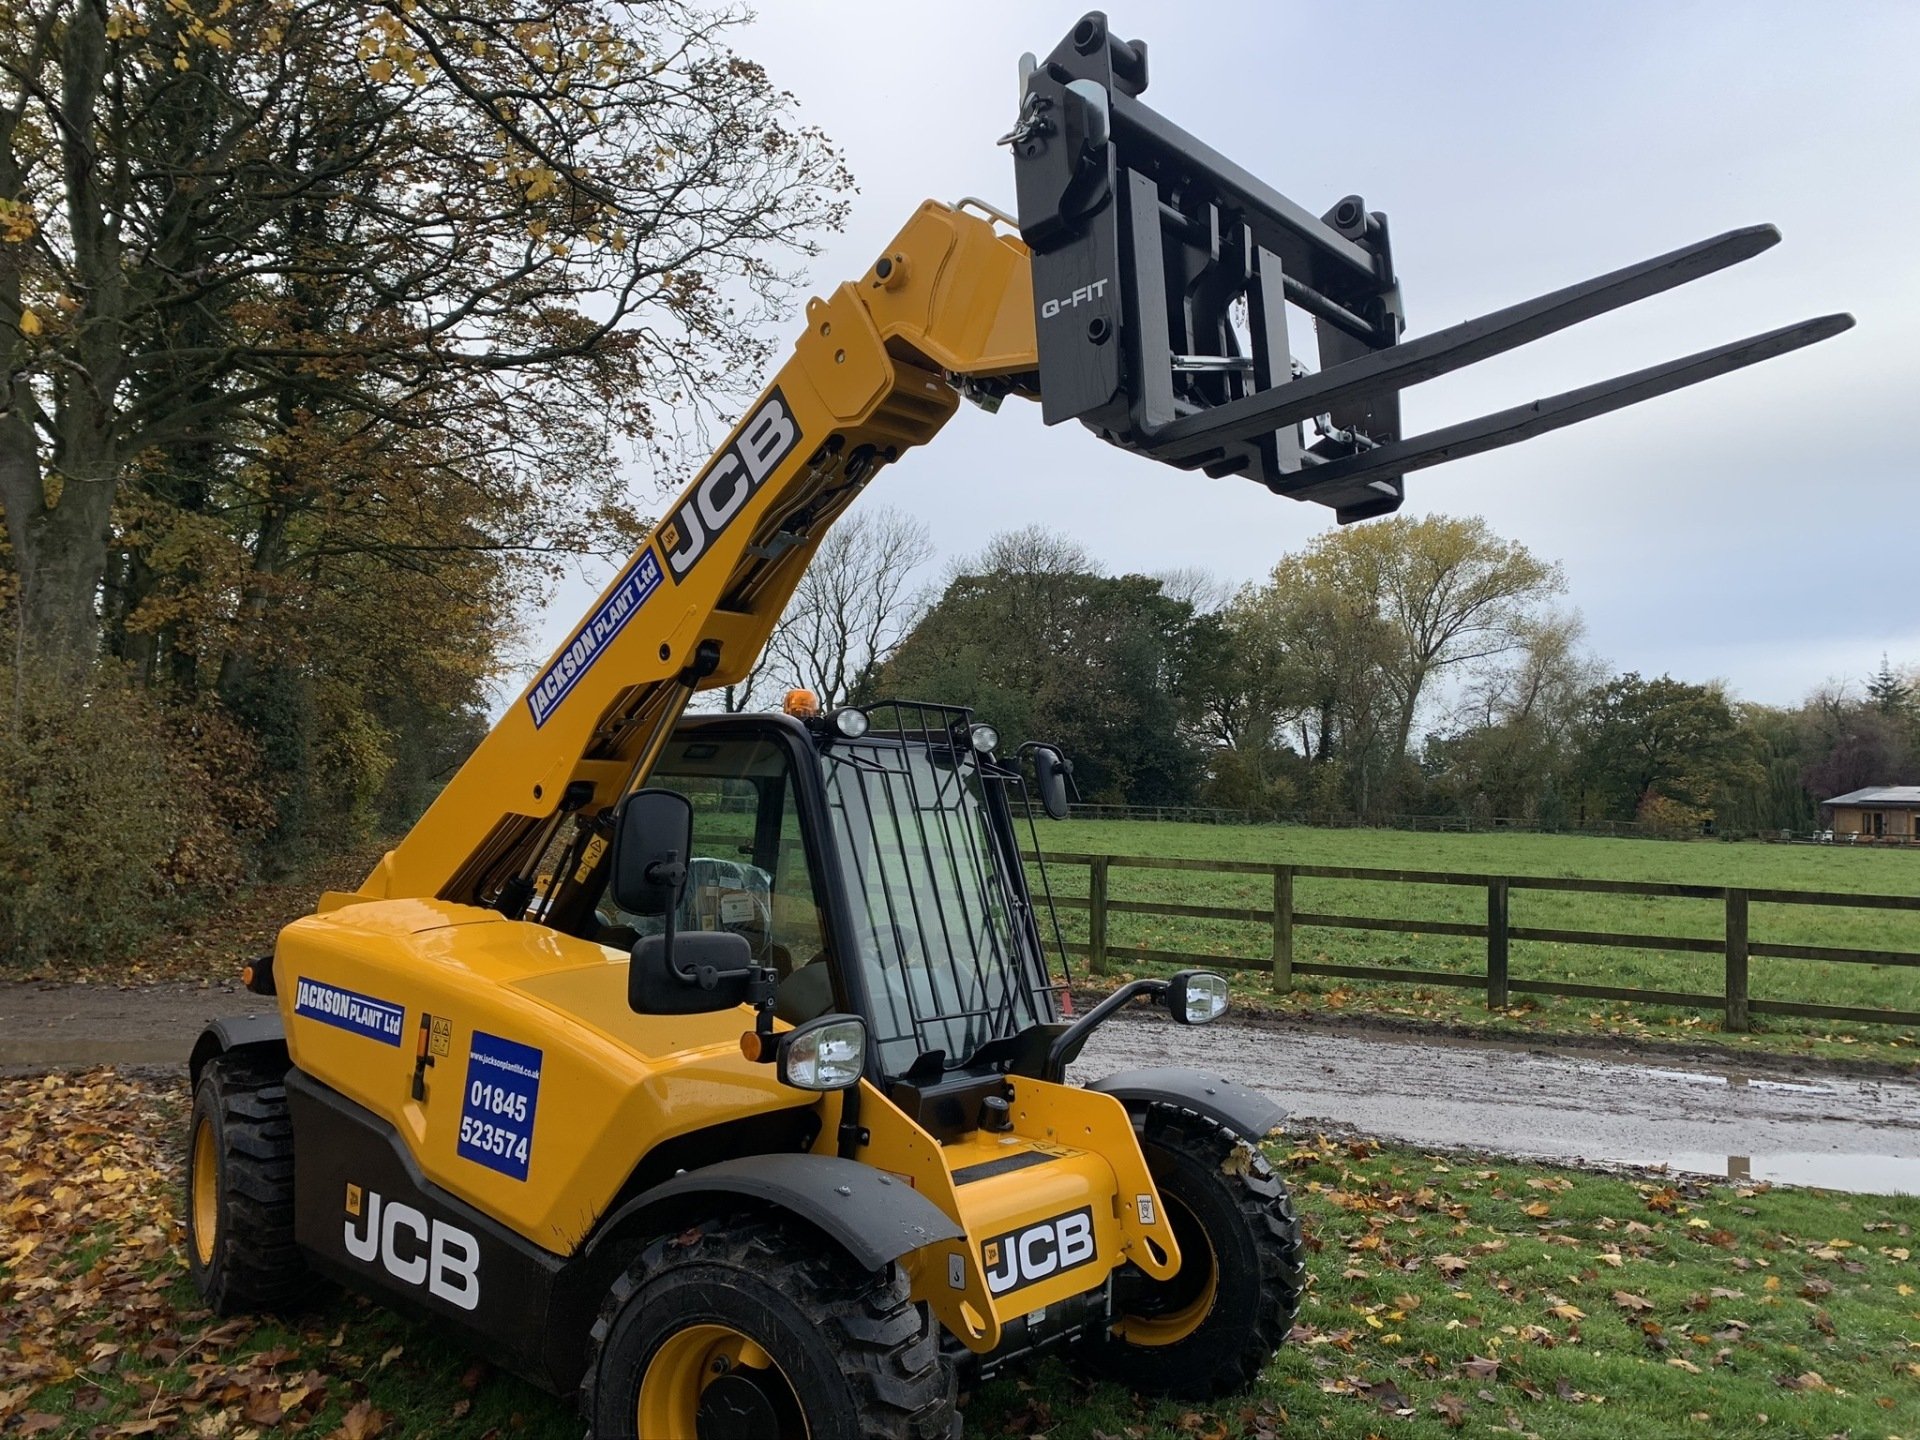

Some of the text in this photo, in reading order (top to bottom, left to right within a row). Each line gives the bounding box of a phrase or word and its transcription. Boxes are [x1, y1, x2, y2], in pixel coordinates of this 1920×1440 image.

[1042, 278, 1108, 318] Q-FIT
[669, 399, 795, 573] JCB
[529, 558, 658, 725] JACKSON PLANT Ltd
[295, 981, 402, 1035] JACKSON PLANT Ltd
[471, 1080, 527, 1122] 01845
[460, 1116, 527, 1164] 523574
[344, 1191, 480, 1310] JCB
[987, 1213, 1094, 1293] JCB
